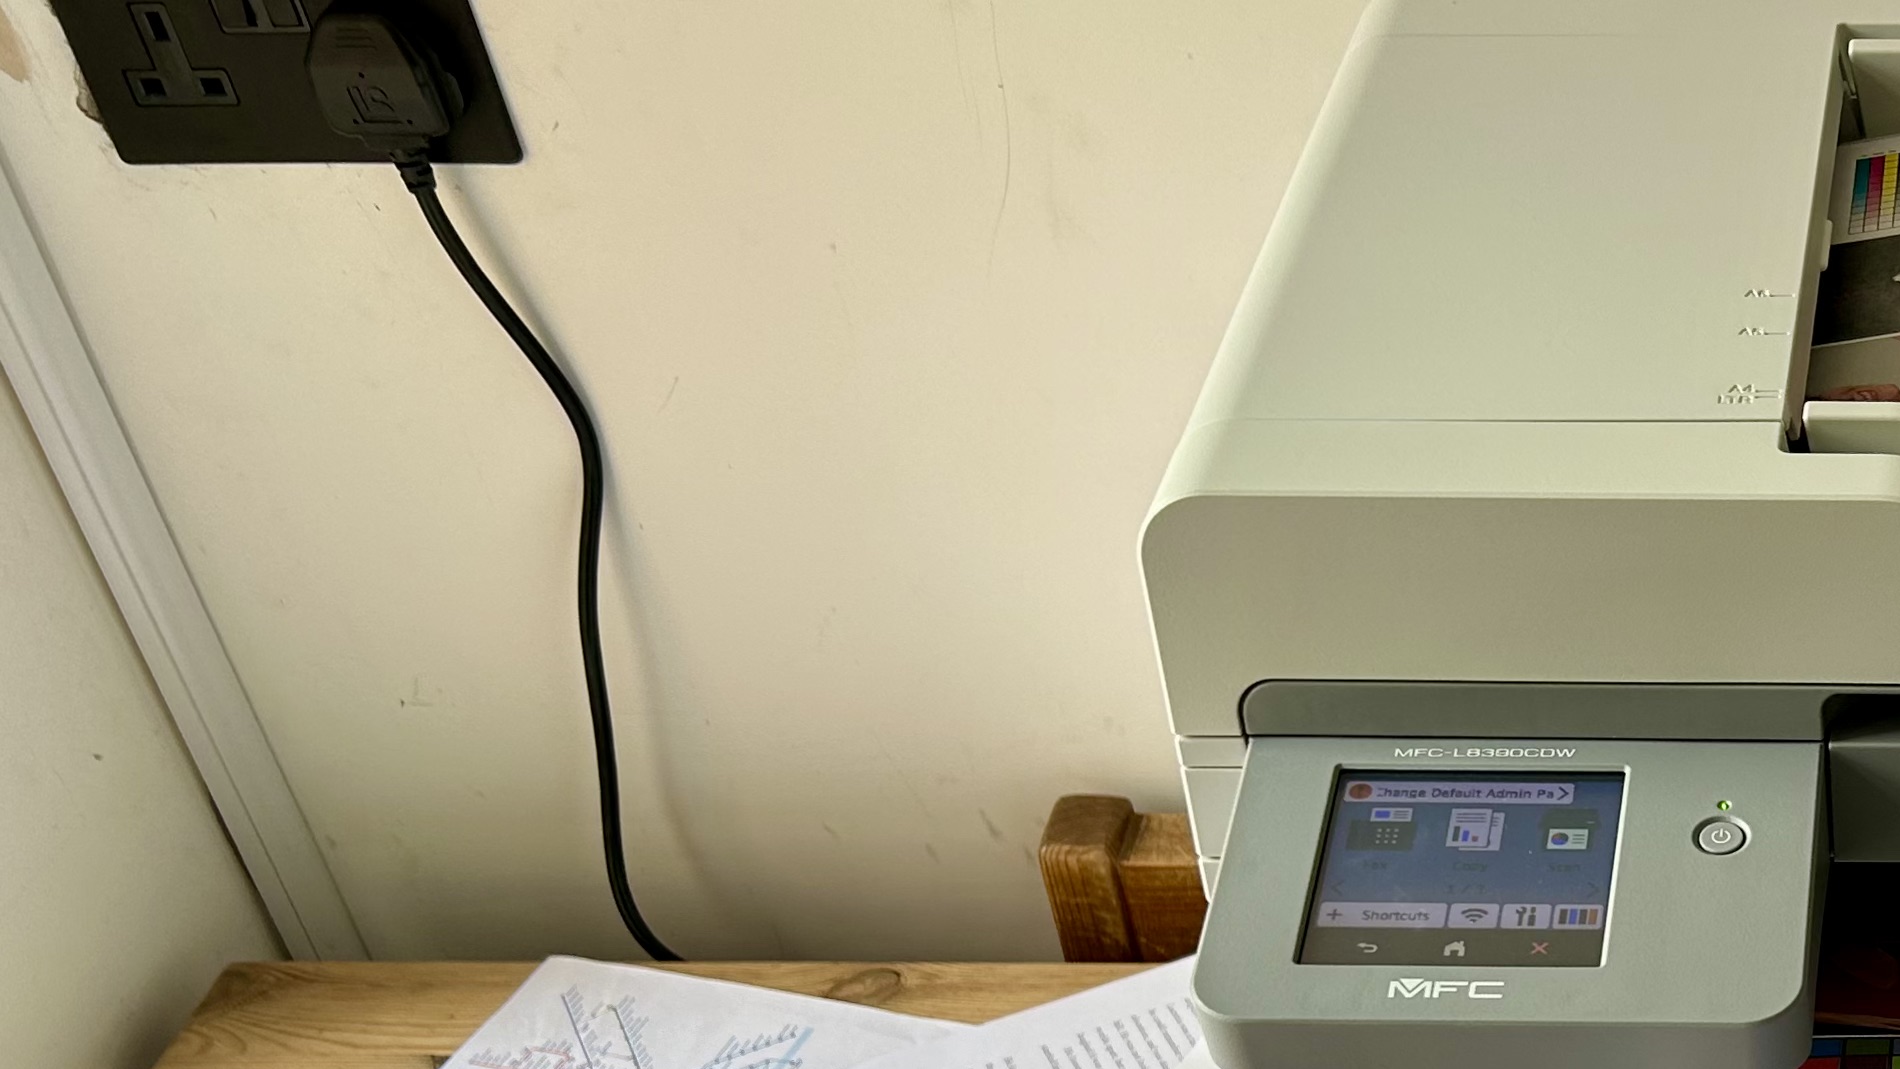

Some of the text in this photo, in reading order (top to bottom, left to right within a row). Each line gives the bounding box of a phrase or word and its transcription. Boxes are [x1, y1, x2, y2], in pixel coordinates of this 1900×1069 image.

[1394, 748, 1576, 758] MFC-L8390CDW
[1431, 788, 1481, 798] Default
[1486, 789, 1531, 799] Admin
[1453, 862, 1487, 873] Copy
[1361, 910, 1430, 921] Shortcuts
[1388, 978, 1505, 999] MFC
